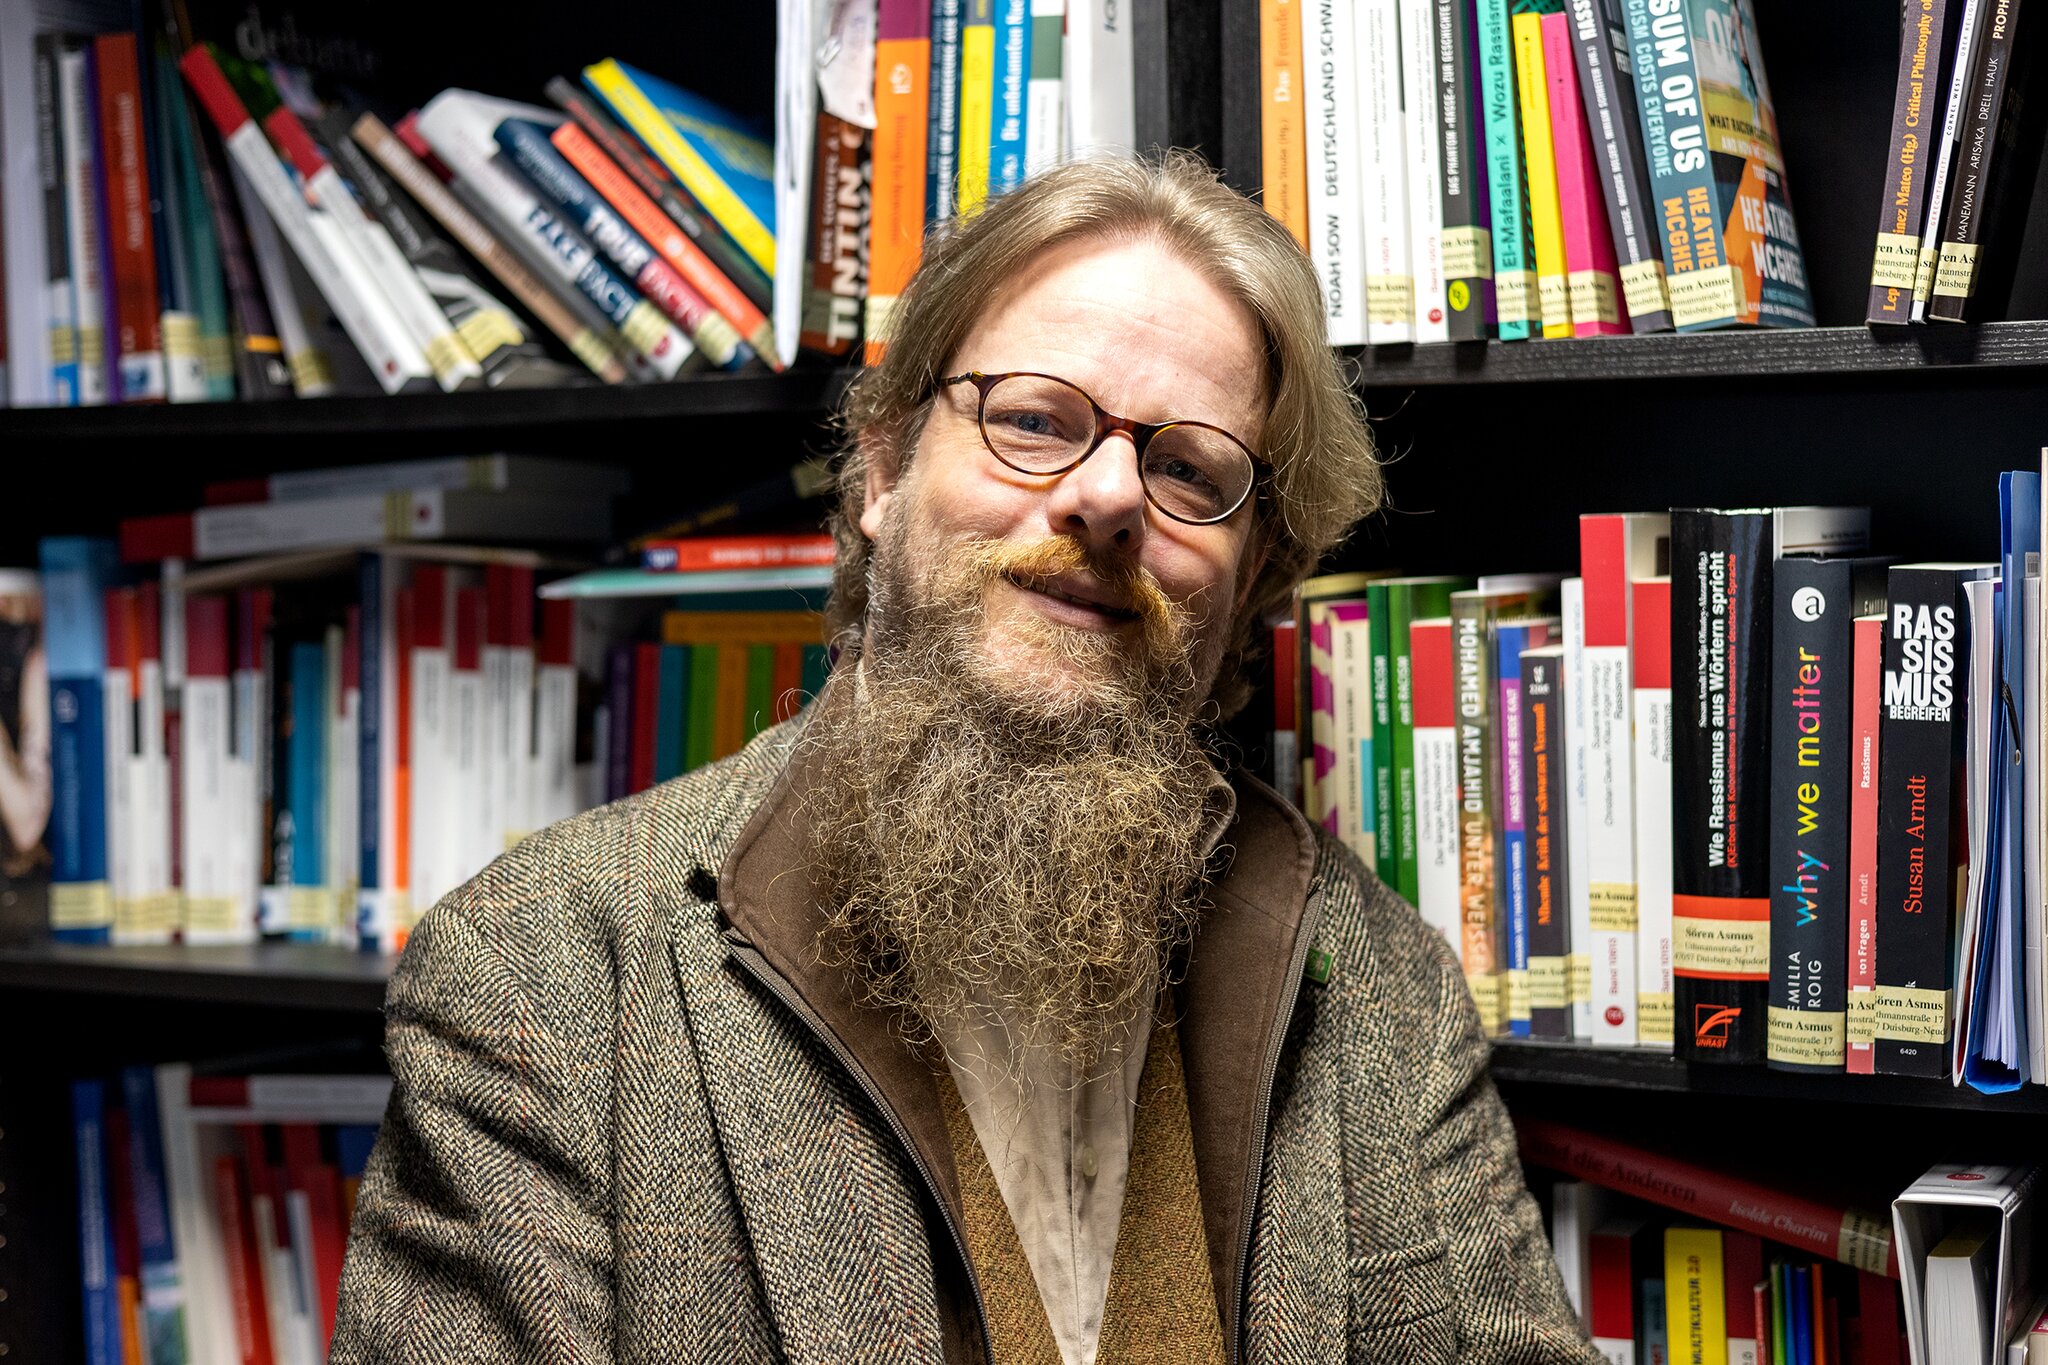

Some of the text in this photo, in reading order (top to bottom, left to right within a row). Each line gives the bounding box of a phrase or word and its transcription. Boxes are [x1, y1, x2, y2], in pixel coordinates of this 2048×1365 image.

[1440, 5, 1453, 63] GESCHICHTE
[1910, 13, 1932, 79] Philosophy
[1274, 72, 1292, 103] Das
[1442, 62, 1454, 83] ZUR
[1628, 0, 1672, 178] CISM COSTS EVERYONE
[1951, 76, 1962, 100] WEST
[1984, 57, 2000, 87] HAUK
[1491, 71, 1507, 122] Wozu
[1660, 75, 1699, 117] OF
[1906, 81, 1923, 128] Critical
[1978, 93, 1993, 121] DRELL
[1708, 111, 1729, 131] WHAT
[1946, 103, 1958, 136] CORNEL
[1445, 129, 1458, 175] PHANTOM
[1669, 122, 1707, 174] US
[1899, 132, 1918, 165] (Hg.)
[1970, 126, 1986, 170] ARISAKA
[1322, 61, 1343, 318] NOAH SOW DEUTSCHLAND
[1447, 175, 1460, 196] DAS
[1896, 166, 1914, 207] Mateo
[1493, 153, 1518, 268] El-Mafaalani
[1688, 185, 1719, 270] HEATHE
[1893, 207, 1908, 235] inez
[1957, 174, 1978, 243] MANEMANN
[583, 202, 652, 277] TRUE
[827, 164, 861, 345] TINTIN
[1662, 197, 1694, 274] MCGHE
[578, 256, 635, 322] FACT
[1669, 283, 1693, 295] ören
[1882, 287, 1901, 312] Lep
[1892, 604, 1955, 641] RAS
[1374, 655, 1387, 702] RACISM
[1397, 655, 1409, 702] RACISM
[1459, 618, 1481, 717] MOHAMED
[1902, 640, 1954, 674] SIS
[1613, 660, 1624, 720] Rassismus
[1708, 550, 1728, 867] Wie Rassismus aus Wörtern spricht
[1726, 553, 1738, 868] (K)Erben des Kolonialismus im Wissensarchiv deutsche Sprache
[1884, 671, 1954, 709] MUS
[1532, 703, 1548, 753] Vernunft
[1662, 703, 1672, 763] Rassismus
[1889, 706, 1952, 723] BEGREIFEN
[1462, 725, 1483, 813] AMJAHID
[1535, 754, 1549, 813] schwarzen
[1782, 647, 1830, 927] why we matter
[1536, 815, 1548, 835] der
[1903, 774, 1927, 914] Susan Arndt
[1465, 819, 1486, 883] UNTER
[1536, 836, 1549, 871] Kritik
[1857, 737, 1872, 977] 101 Fragen Arndt Rassismus
[1467, 892, 1488, 976] WEISSEN
[1685, 927, 1753, 941] Sören Asmus
[1745, 945, 1754, 953] 17
[1696, 954, 1768, 967] Duisburg-Neudorf
[1787, 950, 1801, 1012] EMILIA
[1807, 959, 1822, 1008] ROIG
[1905, 997, 1943, 1011] Asmus
[1789, 1020, 1833, 1032] Asmus
[1874, 1011, 1944, 1024] thmannstraße 17
[1696, 1036, 1727, 1048] UNRAST
[1823, 1036, 1834, 1045] 17
[1899, 1048, 1917, 1056] 6420
[1609, 1162, 1697, 1205] Anderen
[1729, 1199, 1829, 1244] Isolde Charim
